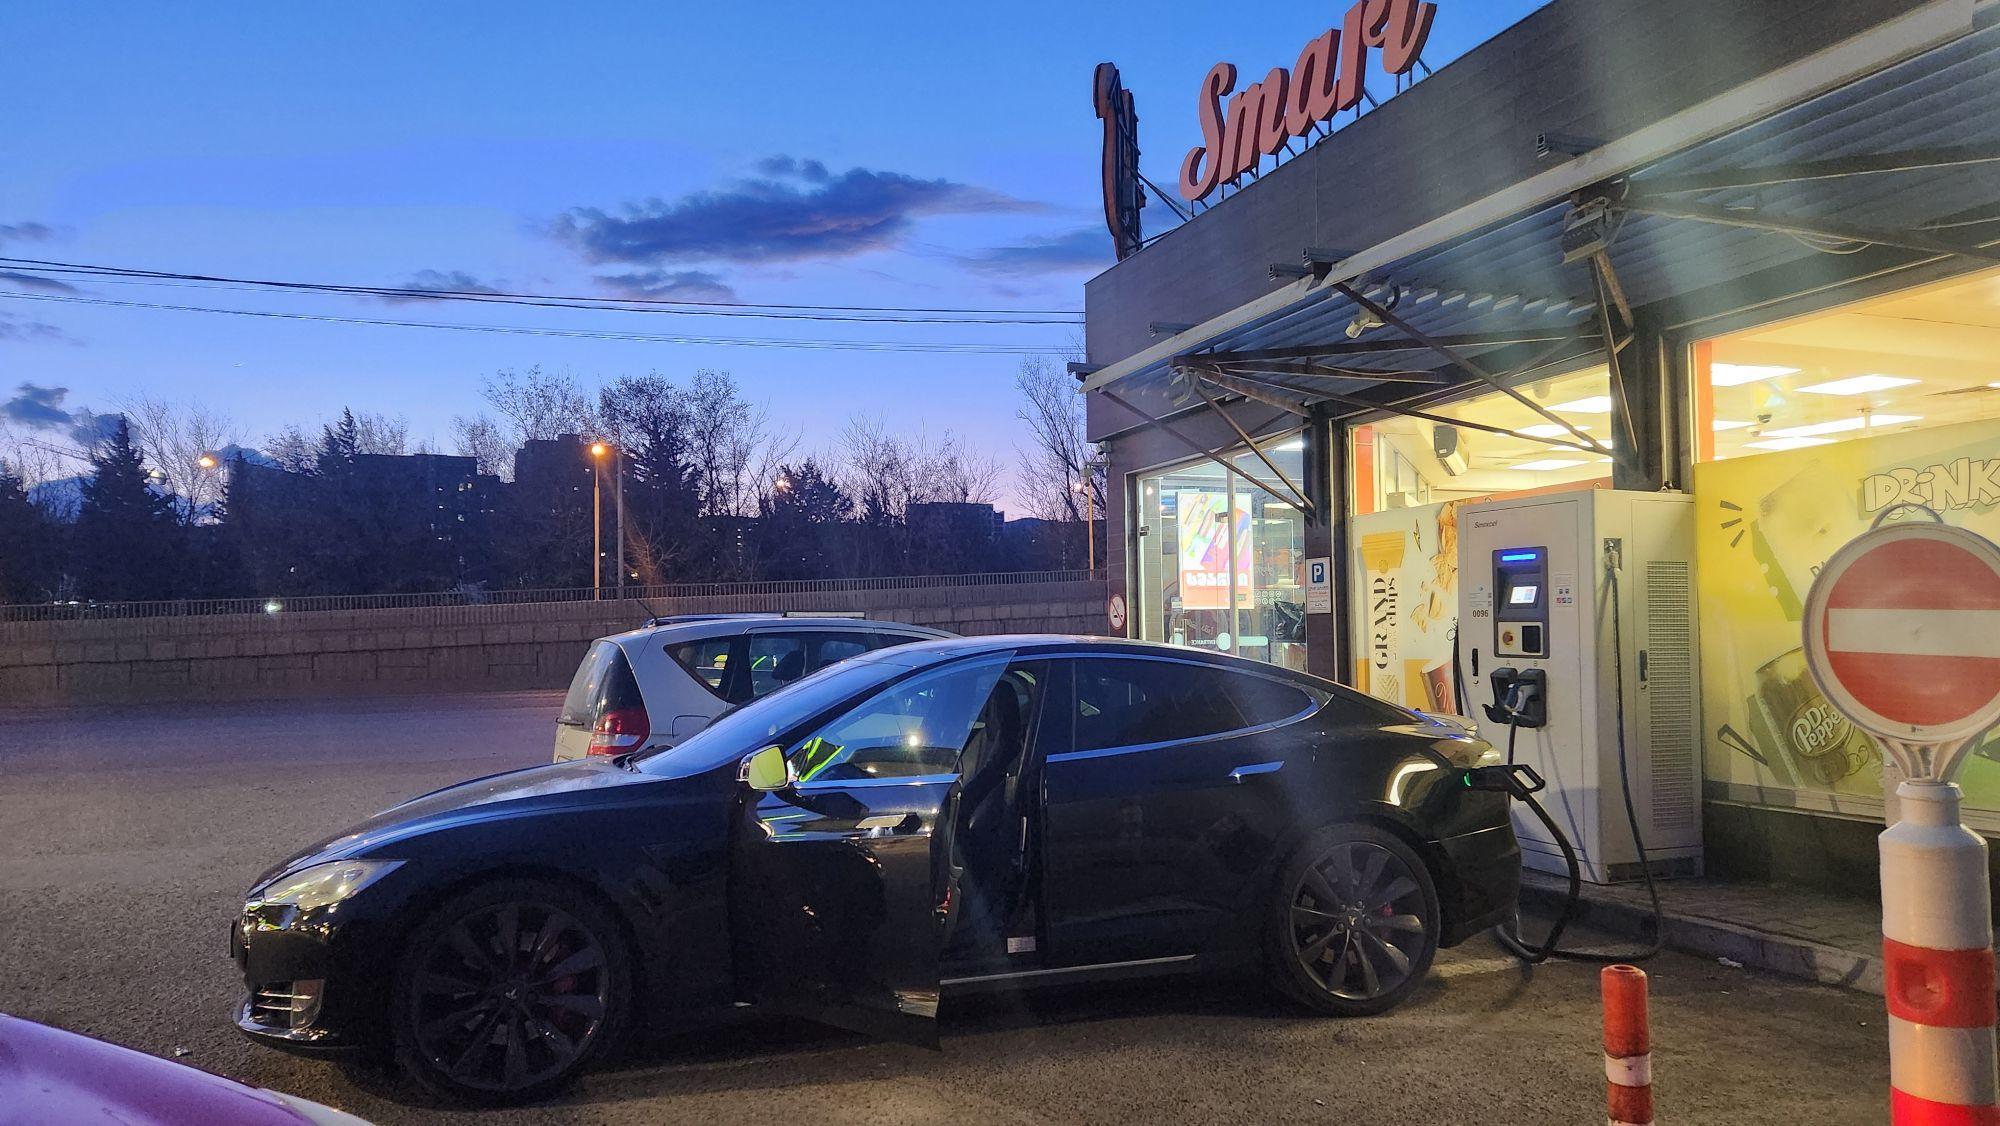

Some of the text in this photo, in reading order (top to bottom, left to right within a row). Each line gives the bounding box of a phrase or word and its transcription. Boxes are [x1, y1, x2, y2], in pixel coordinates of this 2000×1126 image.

[1313, 565, 1322, 582] P
[1373, 577, 1388, 669] GRAND
[1472, 609, 1489, 618] 0096
[1804, 703, 1829, 730] Dr
[1792, 711, 1845, 754] Peppe
